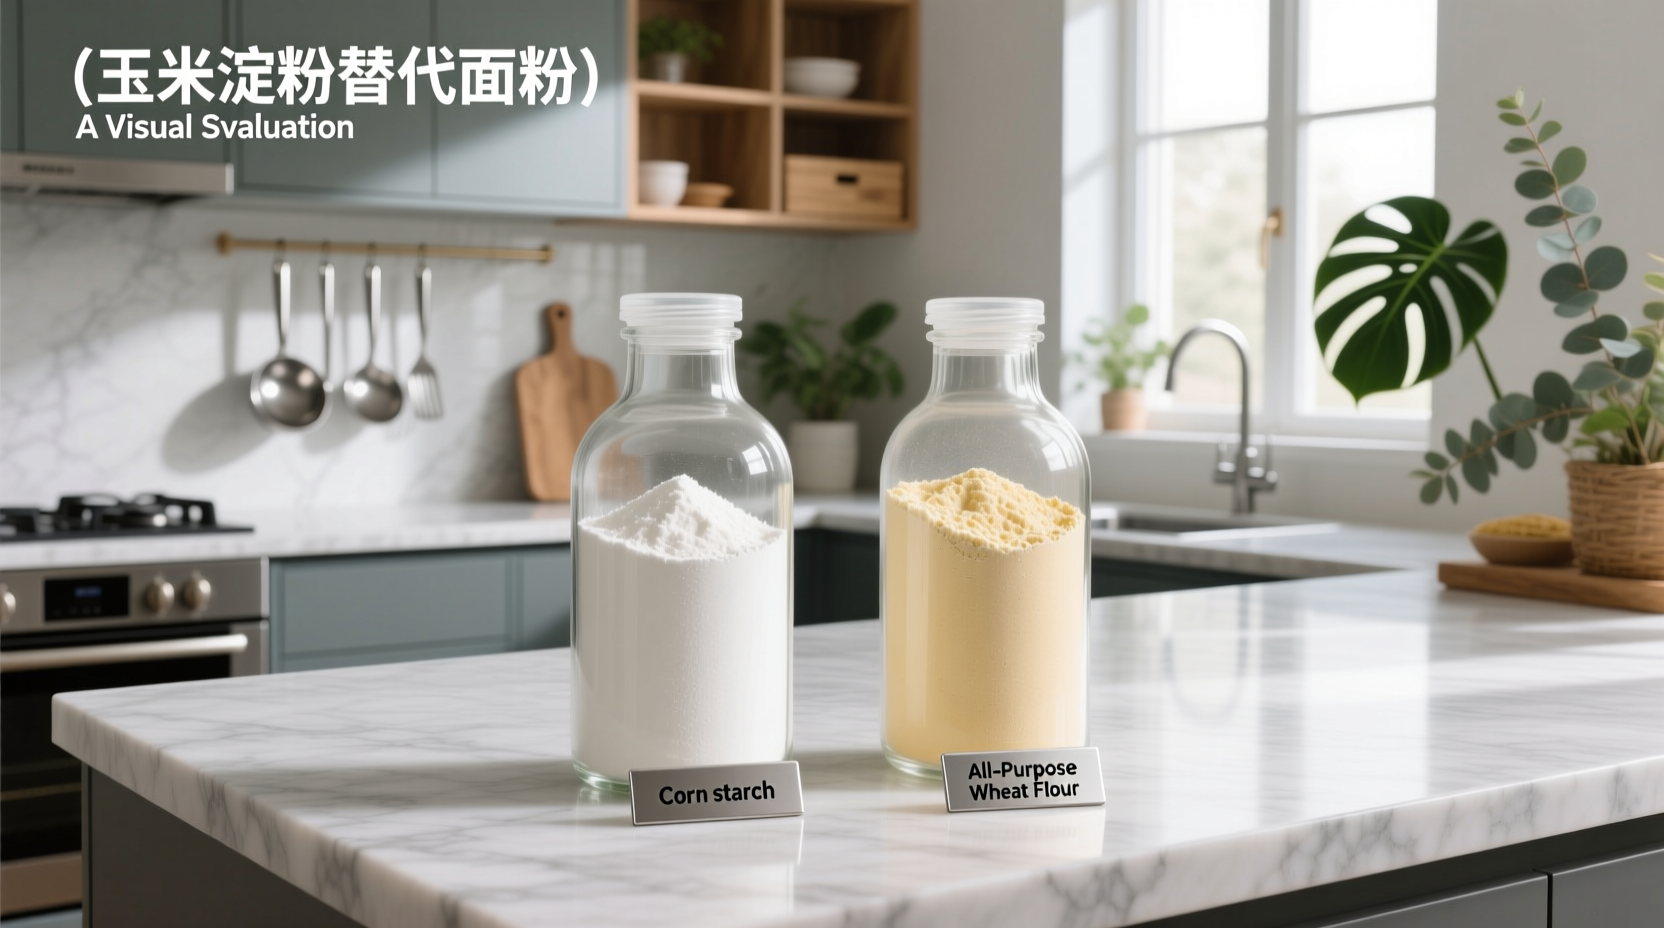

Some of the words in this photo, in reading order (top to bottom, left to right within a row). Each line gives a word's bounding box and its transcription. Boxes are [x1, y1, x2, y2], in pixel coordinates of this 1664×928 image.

[968, 761, 1078, 781] All-Purpose
[658, 785, 708, 806] Corn
[712, 779, 775, 803] starch
[968, 783, 1029, 801] Wheat
[1034, 781, 1080, 798] Flour
